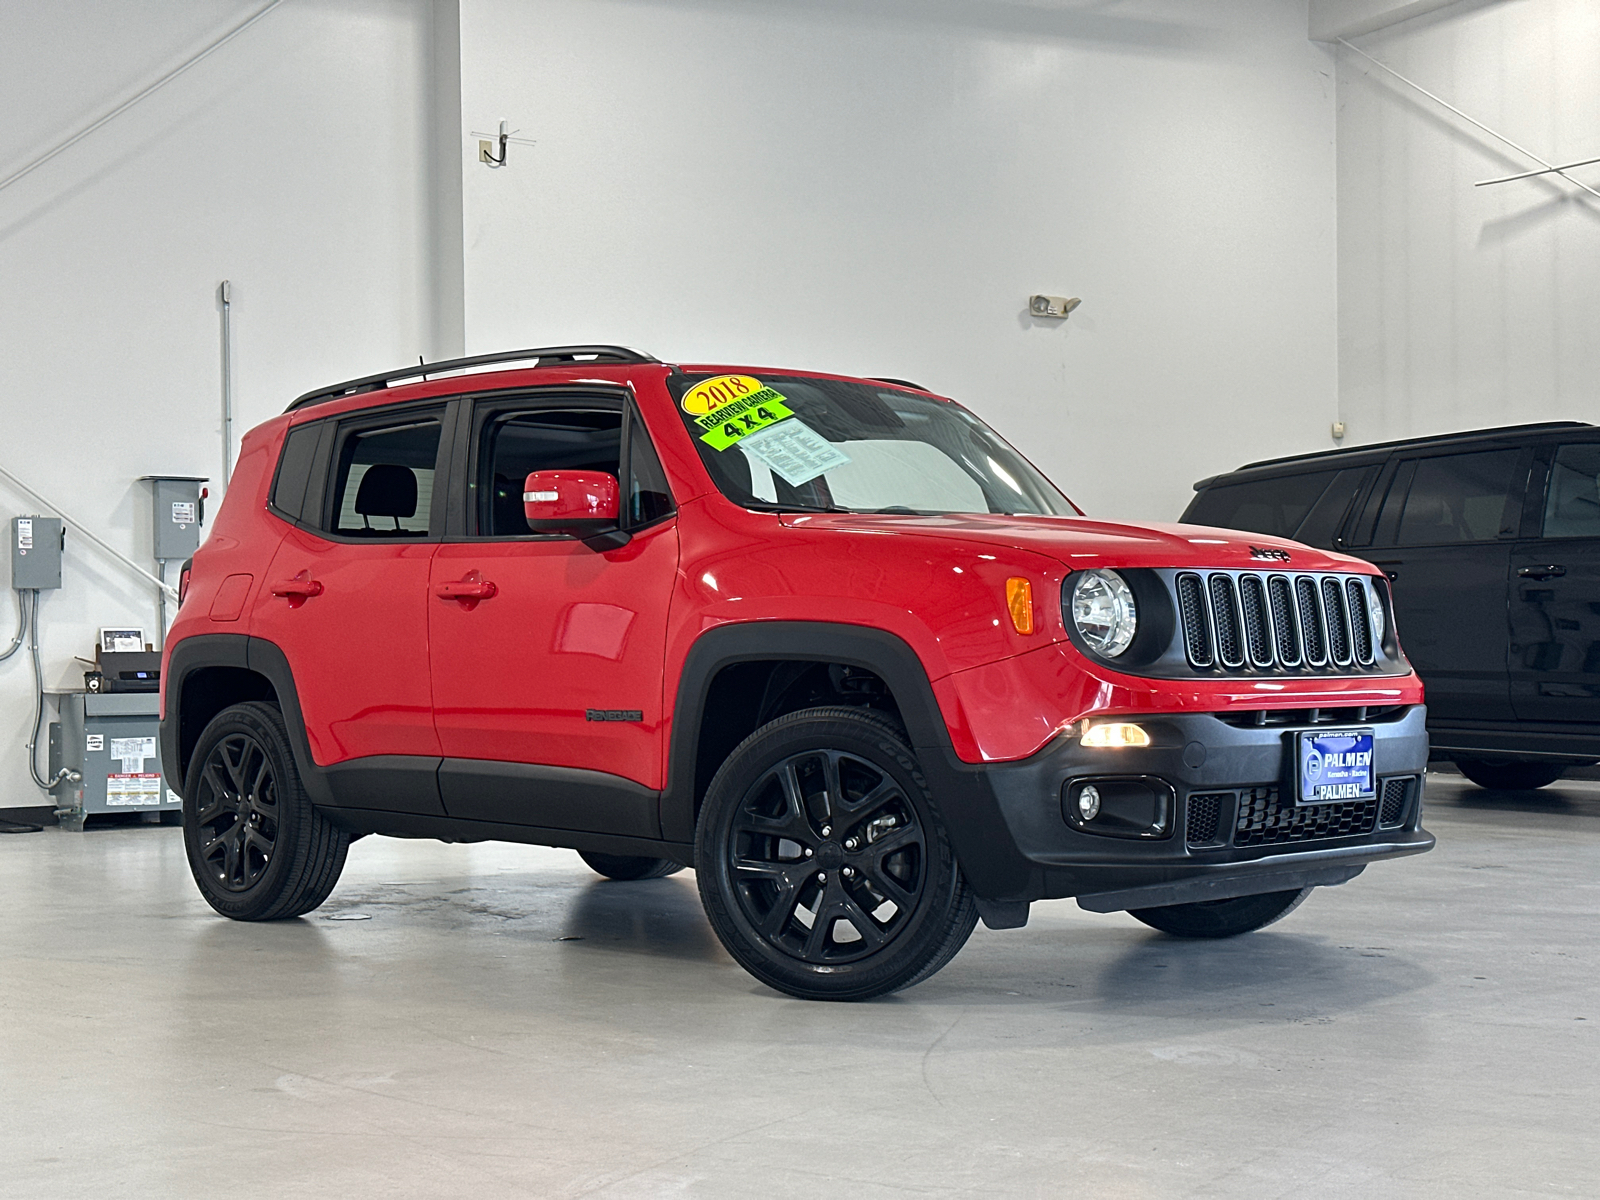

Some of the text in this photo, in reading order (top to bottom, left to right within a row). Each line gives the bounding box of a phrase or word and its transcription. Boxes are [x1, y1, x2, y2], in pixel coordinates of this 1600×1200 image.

[696, 377, 750, 411] 2018
[700, 388, 779, 429] REARVIEW CAMERA
[723, 422, 746, 438] 4
[756, 407, 779, 421] 4
[1248, 545, 1291, 563] Jeep
[586, 709, 643, 721] RENEGADE
[1324, 751, 1371, 768] PALMEN
[1320, 783, 1360, 800] PALMEN
